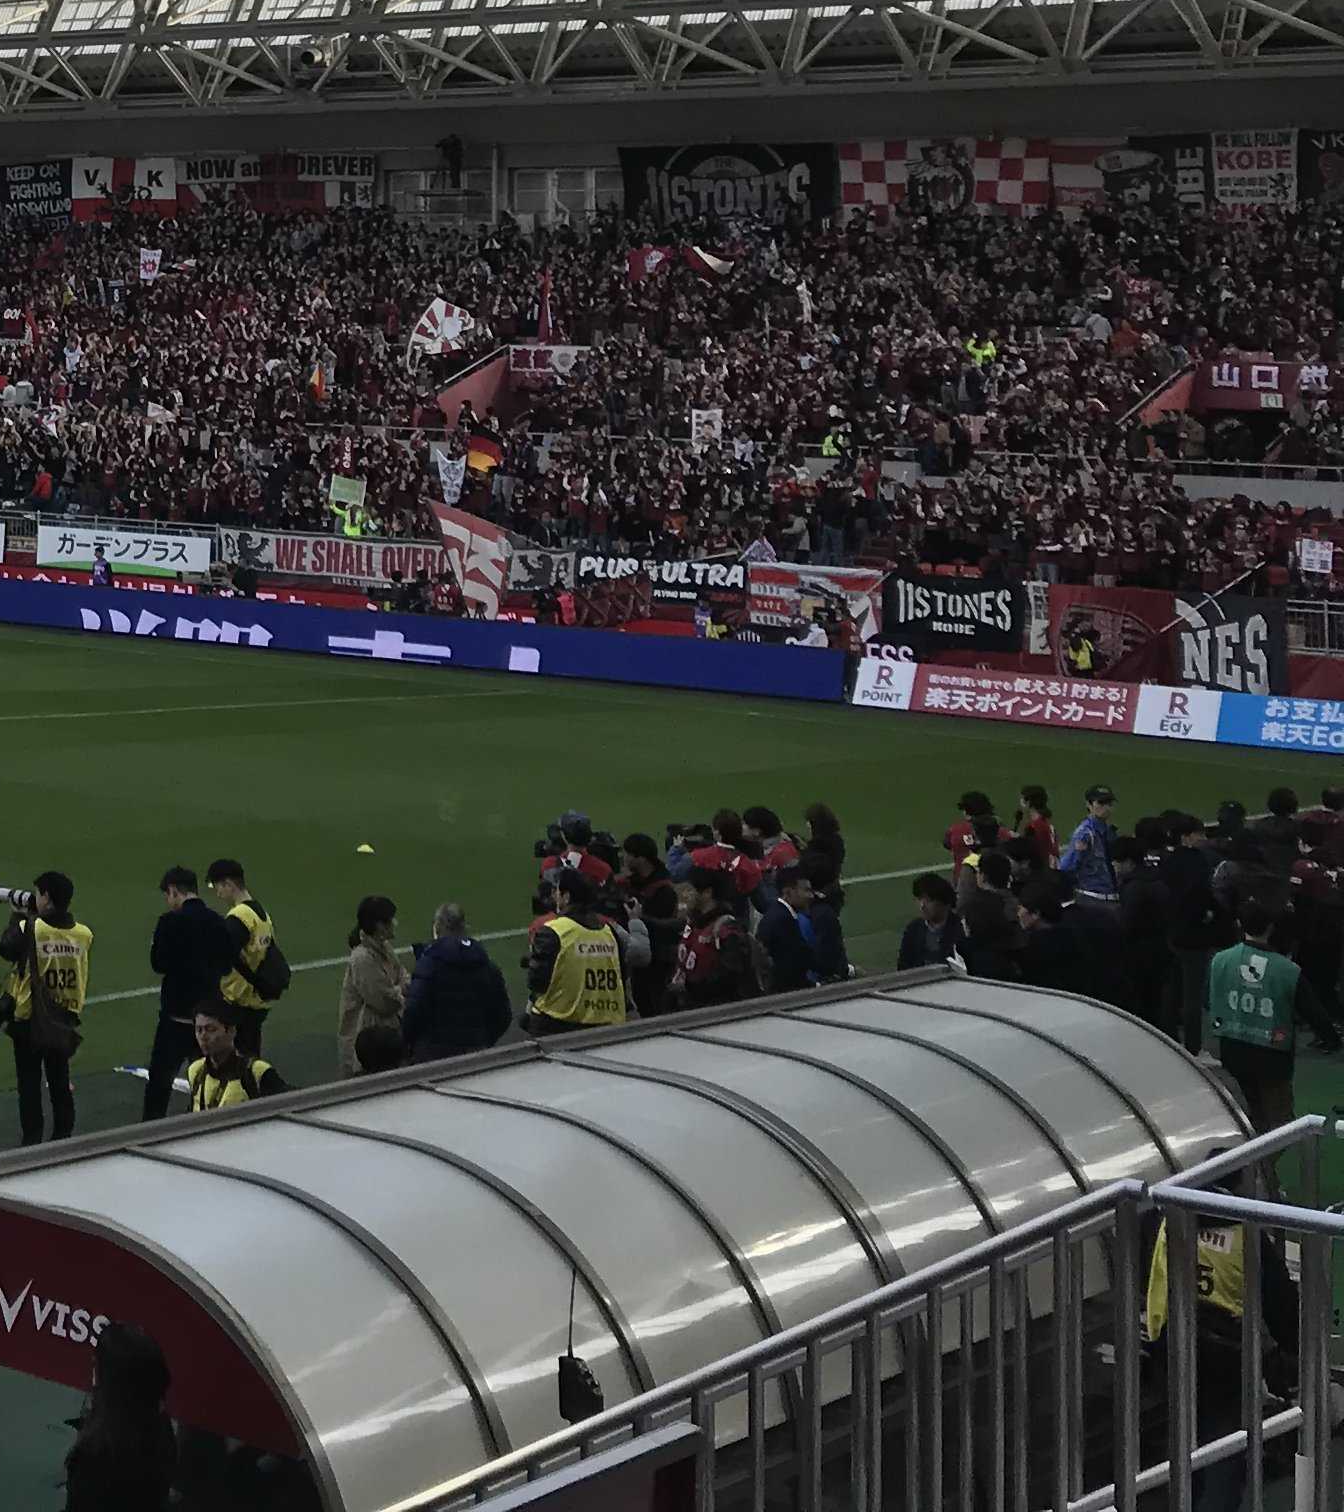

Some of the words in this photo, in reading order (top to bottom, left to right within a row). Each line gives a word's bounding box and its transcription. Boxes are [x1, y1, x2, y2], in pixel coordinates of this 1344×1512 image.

[186, 159, 235, 181] NOW
[296, 154, 374, 177] OREVER
[1216, 150, 1292, 170] KOBE
[57, 533, 188, 563] ガーデンプラス
[275, 538, 307, 572] WE
[312, 541, 373, 577] SHALL
[662, 561, 745, 589] ULTRA
[861, 690, 903, 704] POINT
[924, 687, 1128, 726] 楽天ポイントカード
[1160, 719, 1193, 735] Edy
[585, 968, 619, 991] 028
